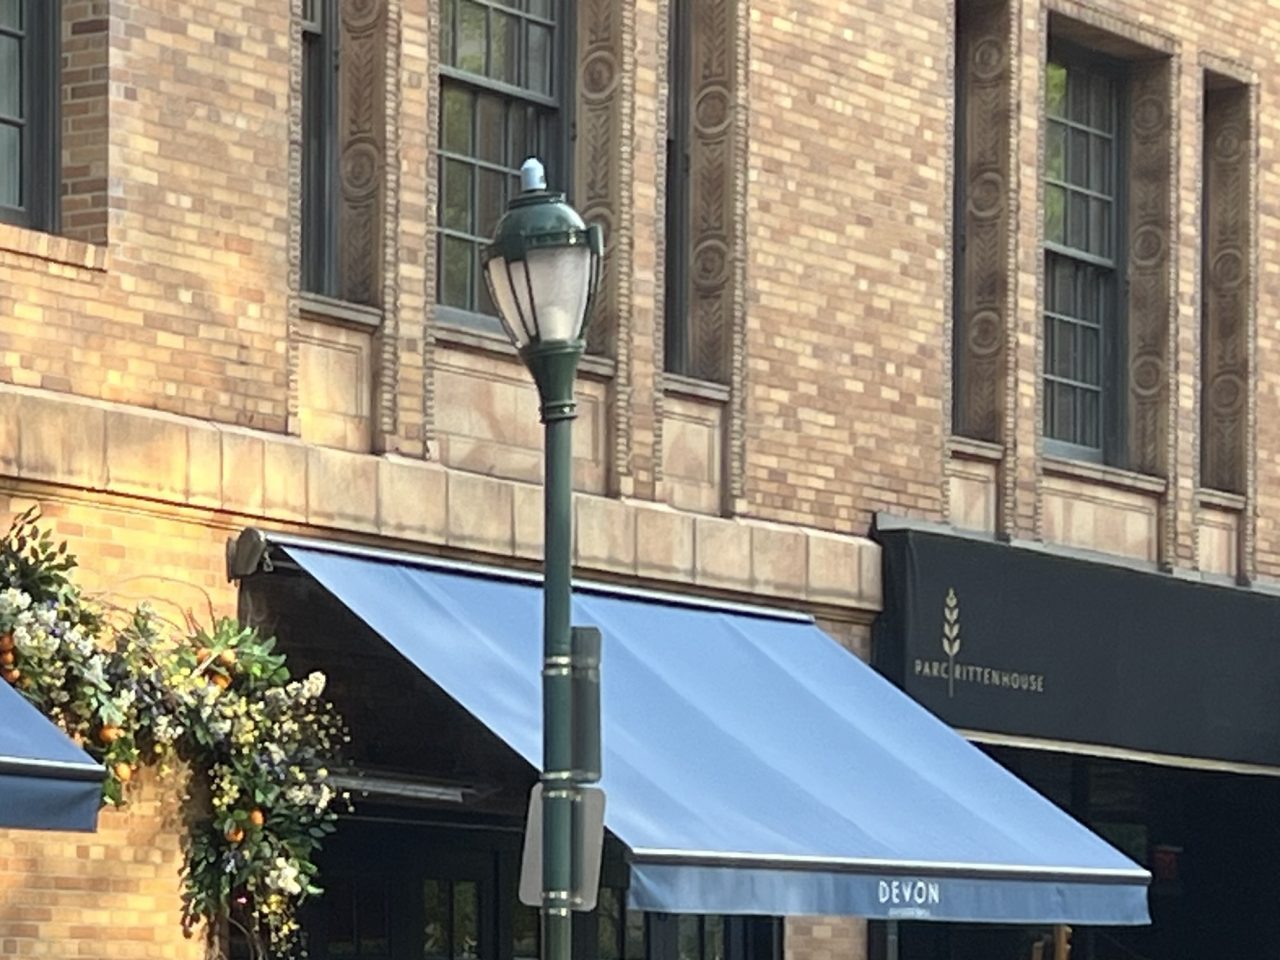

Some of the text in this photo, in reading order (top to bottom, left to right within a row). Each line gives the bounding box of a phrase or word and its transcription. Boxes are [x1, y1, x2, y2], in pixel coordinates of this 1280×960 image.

[914, 659, 1044, 692] PARC RITTENHOUSE
[878, 880, 940, 904] DEVON
